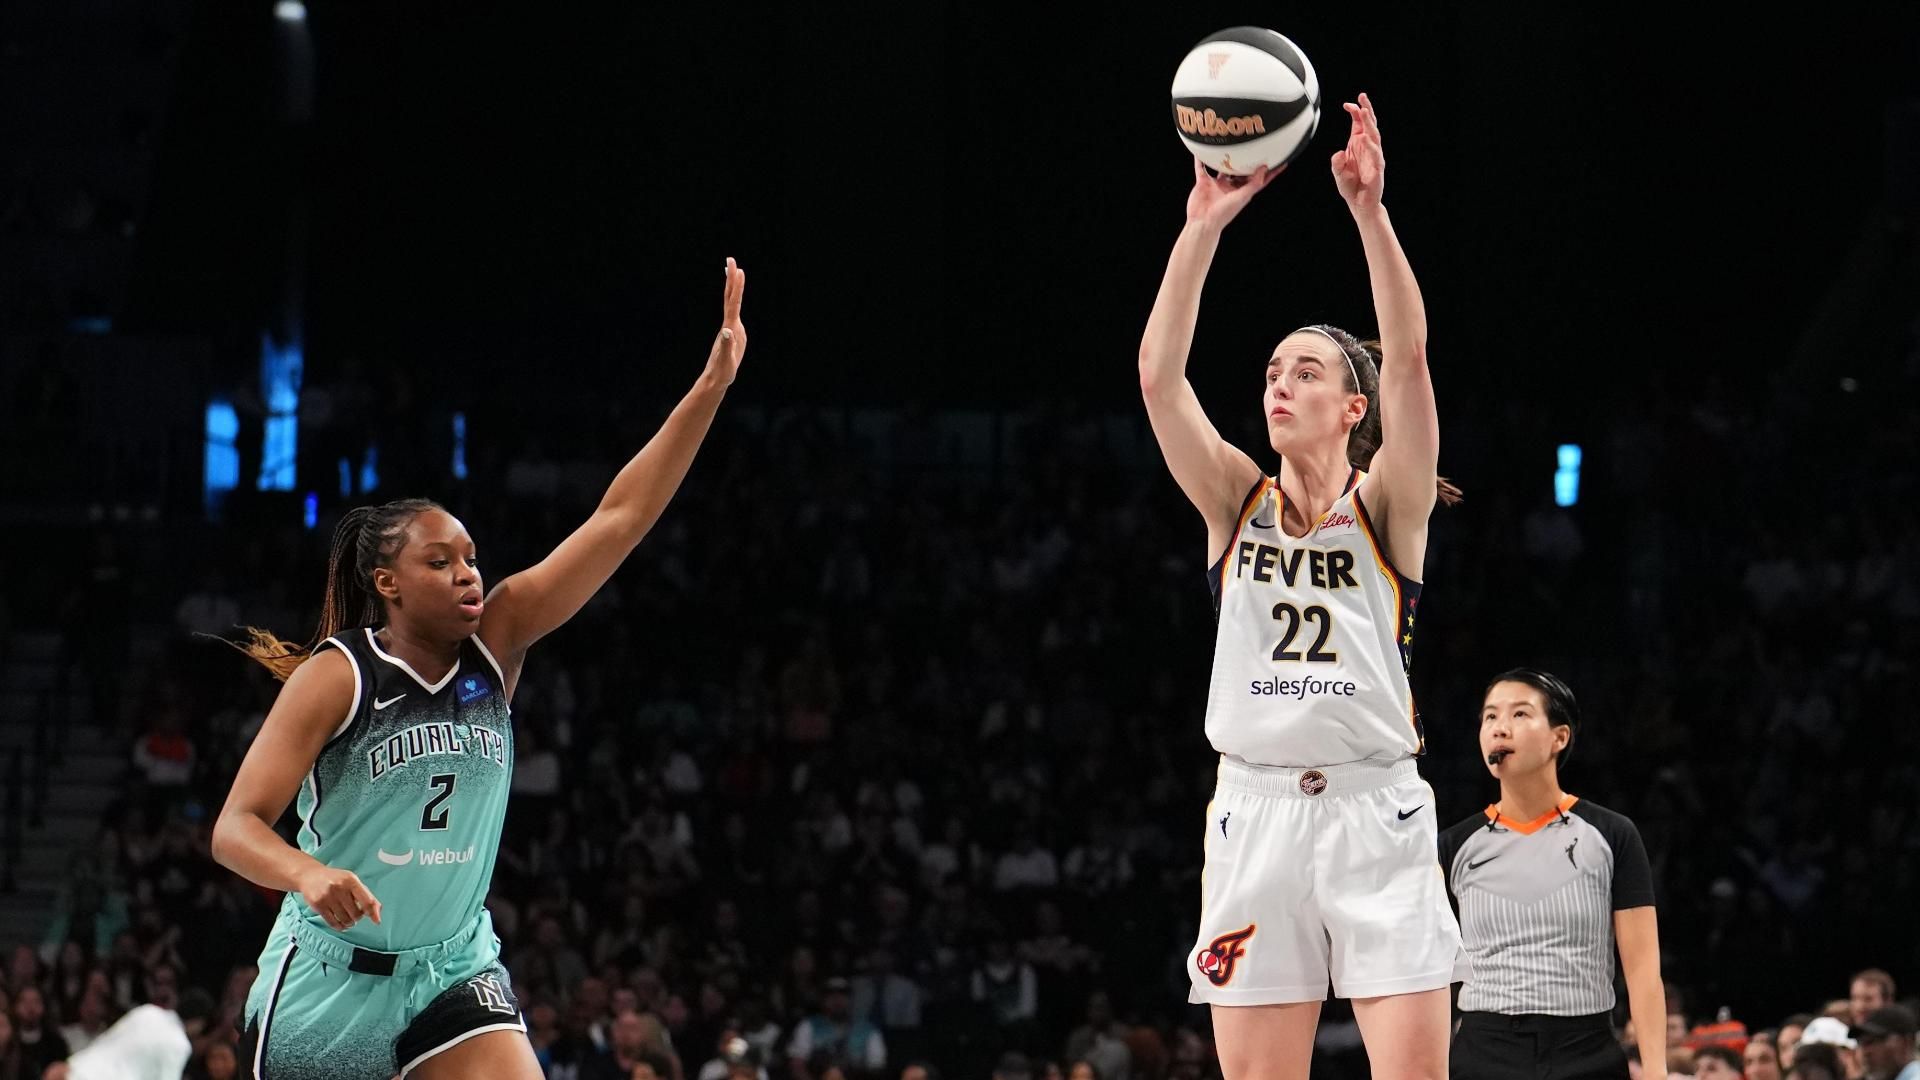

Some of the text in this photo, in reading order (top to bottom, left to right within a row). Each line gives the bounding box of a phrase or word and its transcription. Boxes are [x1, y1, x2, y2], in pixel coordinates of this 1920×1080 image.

[1176, 103, 1266, 137] Wilson
[1320, 512, 1354, 530] Lilly
[1236, 540, 1360, 591] FEVER
[1271, 601, 1338, 664] 22
[1250, 676, 1356, 700] salesforce
[418, 772, 458, 832] 2
